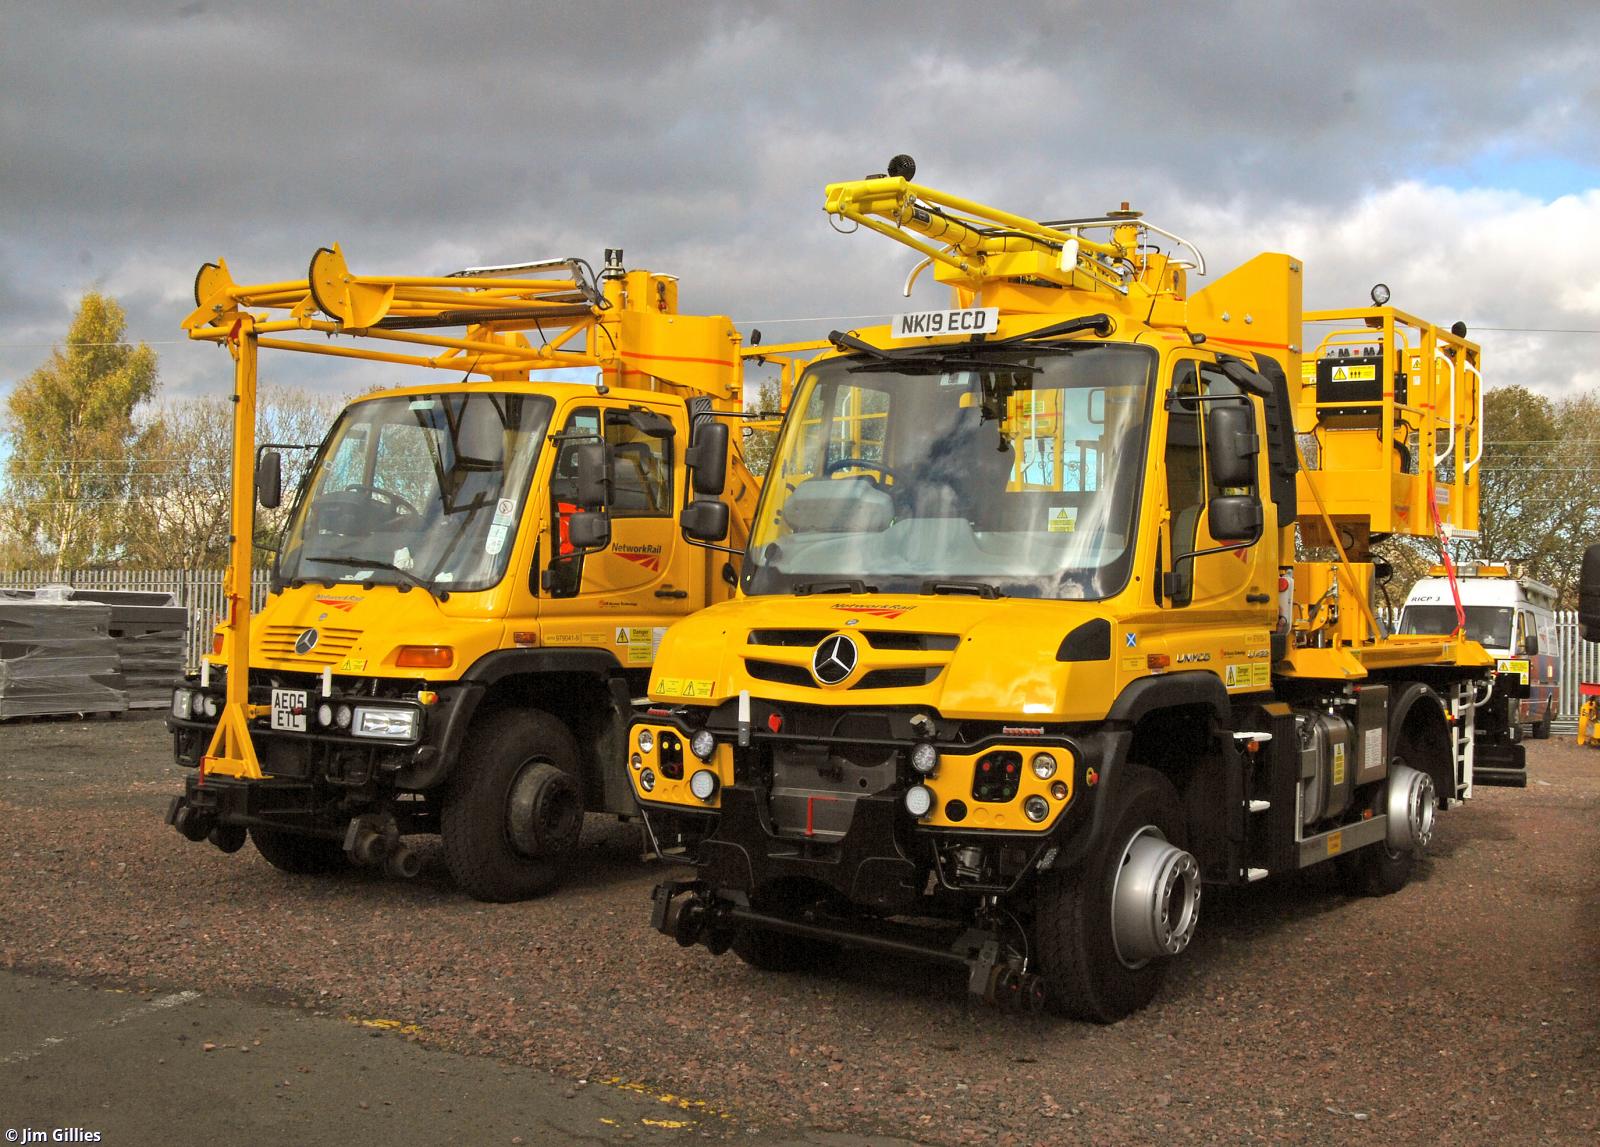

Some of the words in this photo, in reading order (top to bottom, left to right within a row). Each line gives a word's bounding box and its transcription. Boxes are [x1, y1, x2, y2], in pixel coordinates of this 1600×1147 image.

[902, 313, 943, 334] NK19
[948, 310, 986, 331] ECD
[612, 542, 662, 554] NetworkRail
[632, 628, 649, 637] Danger
[274, 692, 304, 709] AE05
[277, 710, 300, 728] ETL
